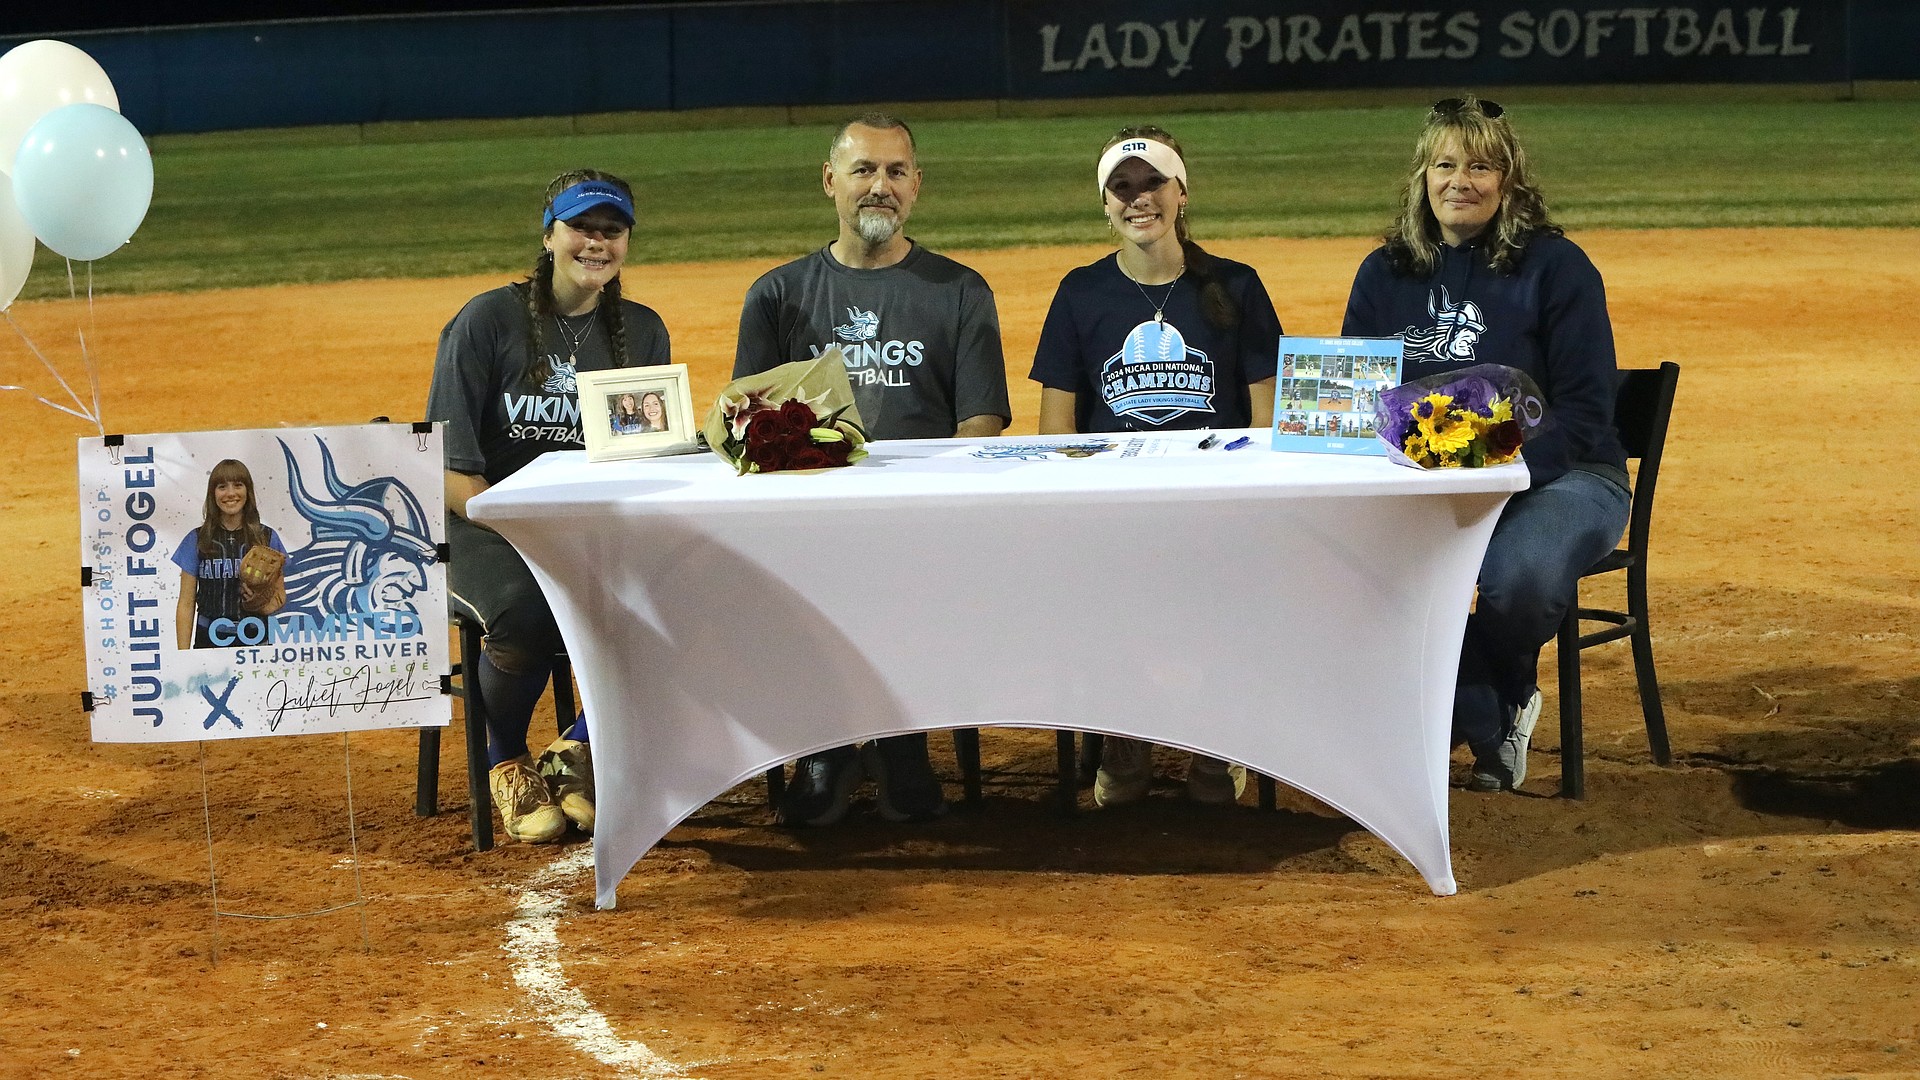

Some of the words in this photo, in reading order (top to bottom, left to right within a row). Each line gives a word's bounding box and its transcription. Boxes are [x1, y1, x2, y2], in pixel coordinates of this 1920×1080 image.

[1039, 19, 1205, 77] LADY
[1224, 11, 1480, 68] PIRATES
[1499, 7, 1812, 58] SOFTBALL
[1104, 372, 1212, 399] CHAMPIONS
[1106, 369, 1124, 382] 2024
[1125, 364, 1151, 374] NJCAA
[1165, 363, 1205, 374] NATIONAL
[504, 392, 581, 427] VIKIN
[508, 424, 585, 446] SOFTBAL
[124, 446, 157, 577] FOGEL
[98, 491, 116, 648] SHORTSTOP
[208, 611, 420, 647] COMMITED
[127, 591, 164, 728] JULIET
[235, 649, 264, 665] ST.
[270, 645, 346, 663] JOHNS
[355, 642, 429, 660] RIVER
[238, 668, 305, 680] STATE
[326, 661, 430, 676] COLLEGE
